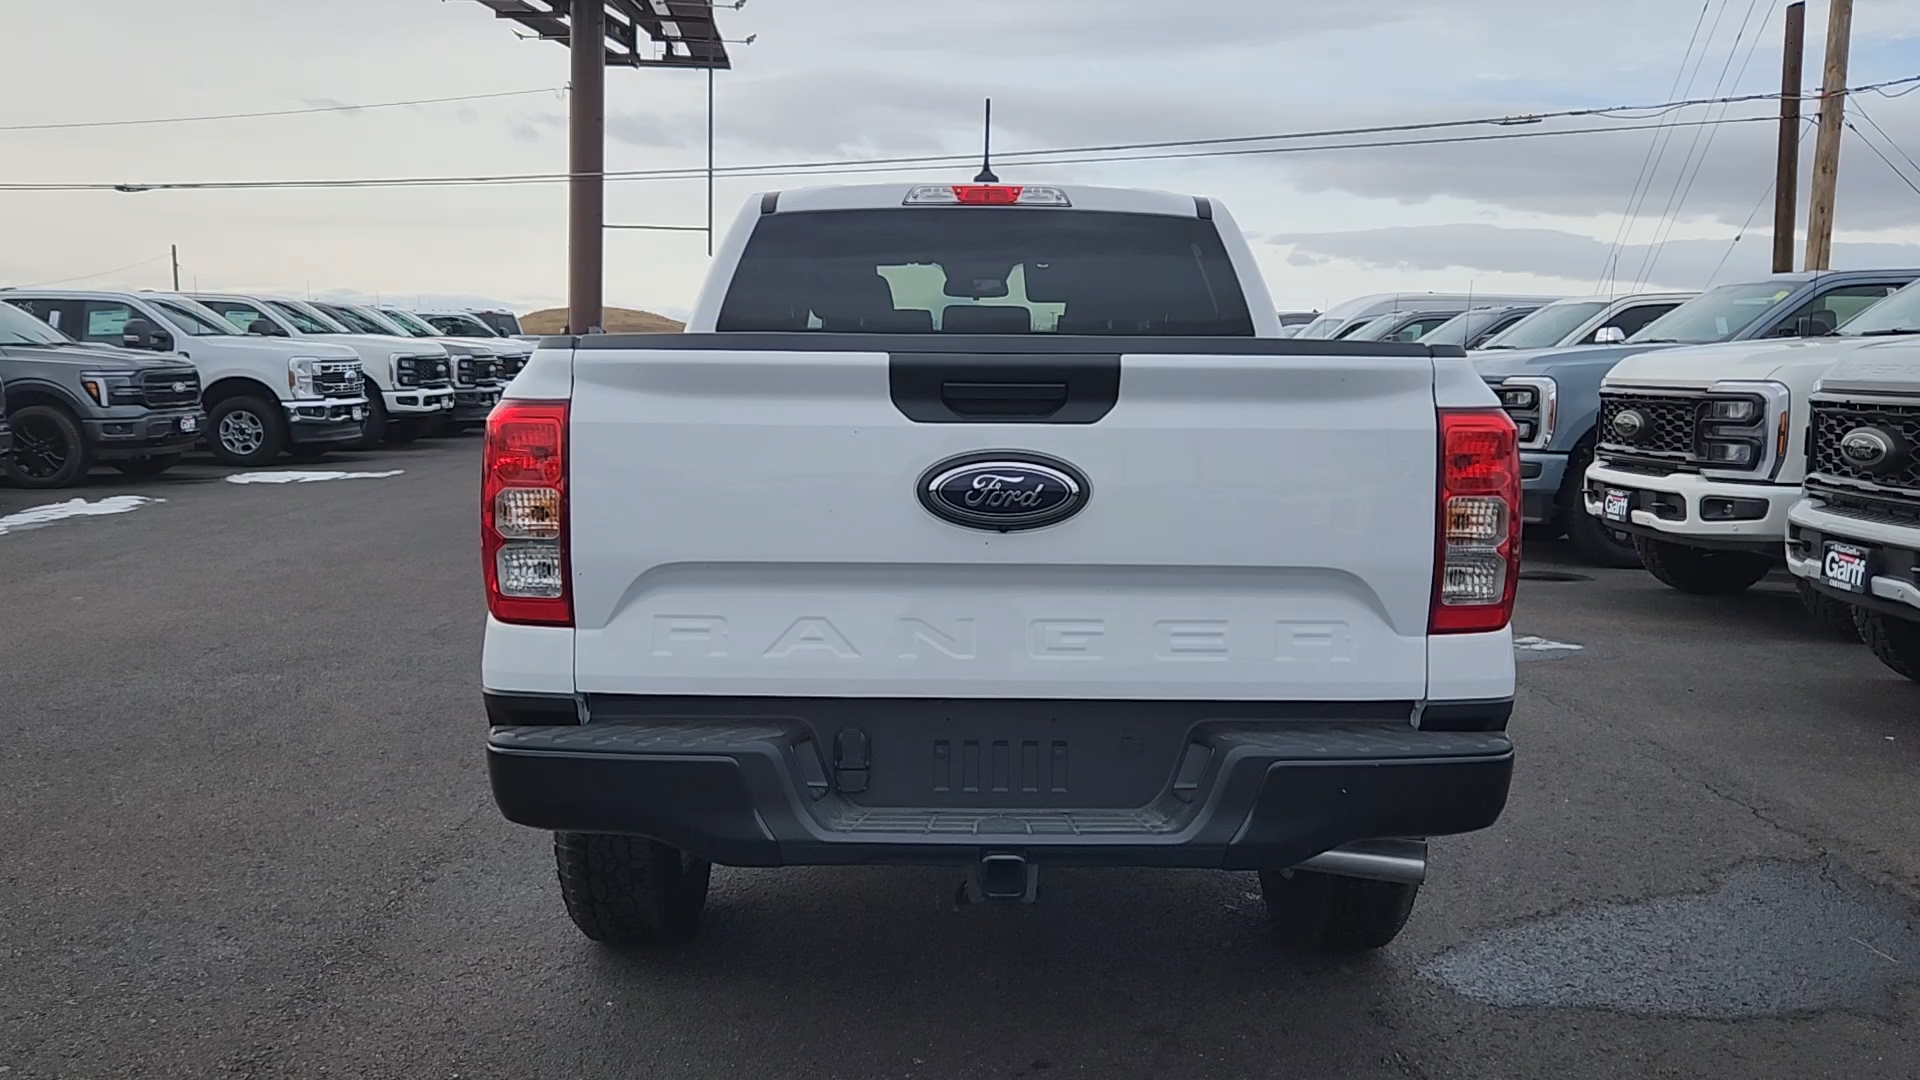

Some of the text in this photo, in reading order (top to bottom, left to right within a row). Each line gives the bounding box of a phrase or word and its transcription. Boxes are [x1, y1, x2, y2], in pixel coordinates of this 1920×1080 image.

[1847, 438, 1874, 459] Ford
[964, 473, 1045, 508] Ford
[1604, 494, 1629, 516] Garff
[1825, 550, 1867, 587] Garff
[650, 612, 1352, 663] RANGER
